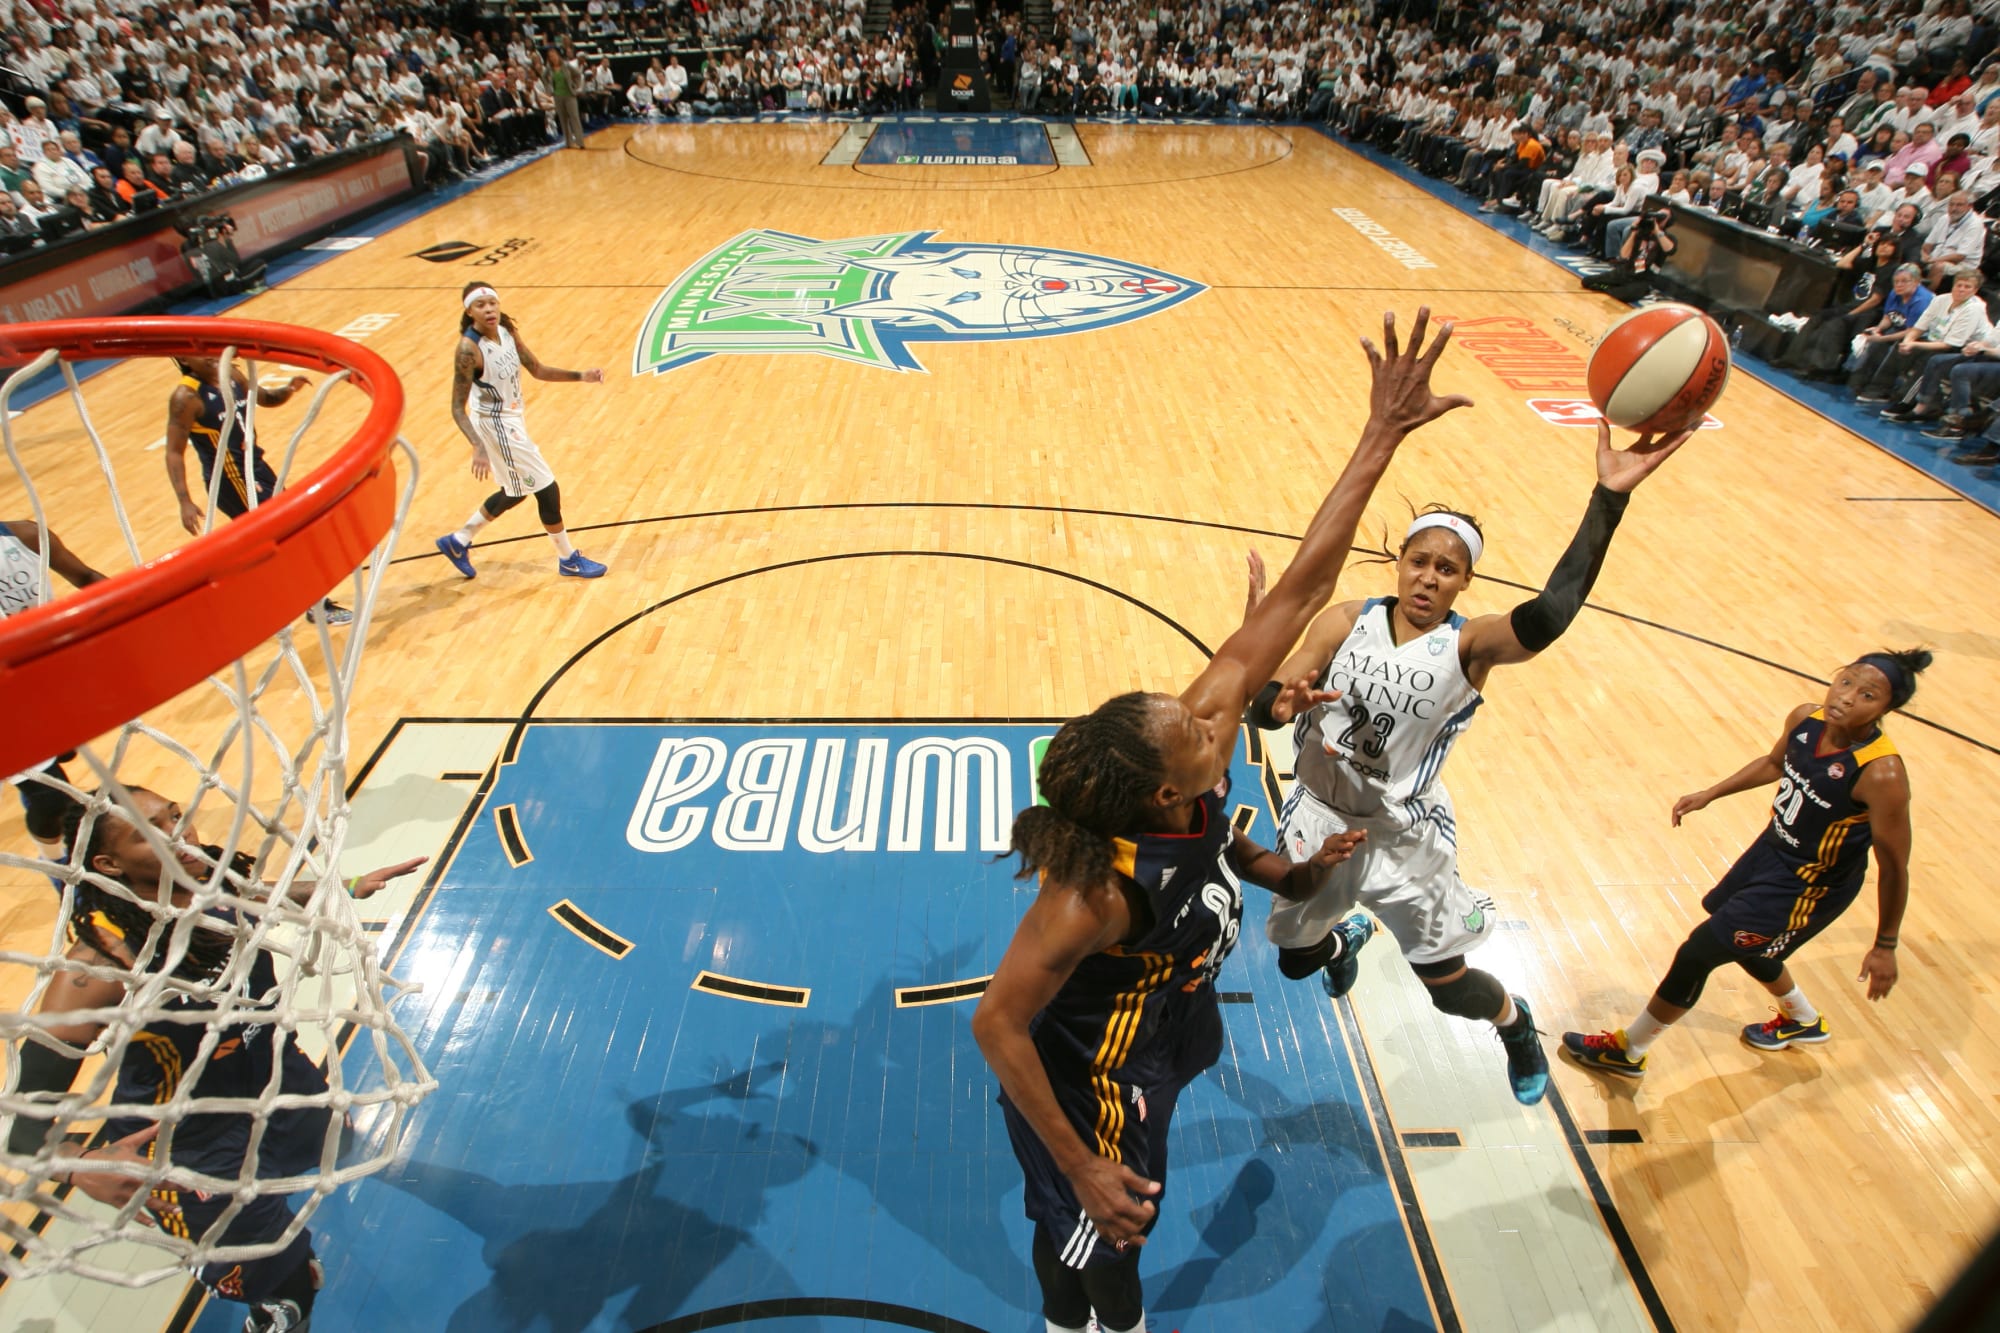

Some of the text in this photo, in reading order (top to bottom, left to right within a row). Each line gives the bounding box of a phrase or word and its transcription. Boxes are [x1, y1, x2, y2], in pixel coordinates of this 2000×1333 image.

[705, 116, 1047, 124] MINNESOTA
[661, 237, 899, 357] LYNX
[668, 248, 748, 329] MINNESOTA
[1331, 671, 1435, 720] CLINIC
[1344, 651, 1435, 692] MAYO
[1337, 704, 1396, 759] 23
[1774, 777, 1804, 826] 20
